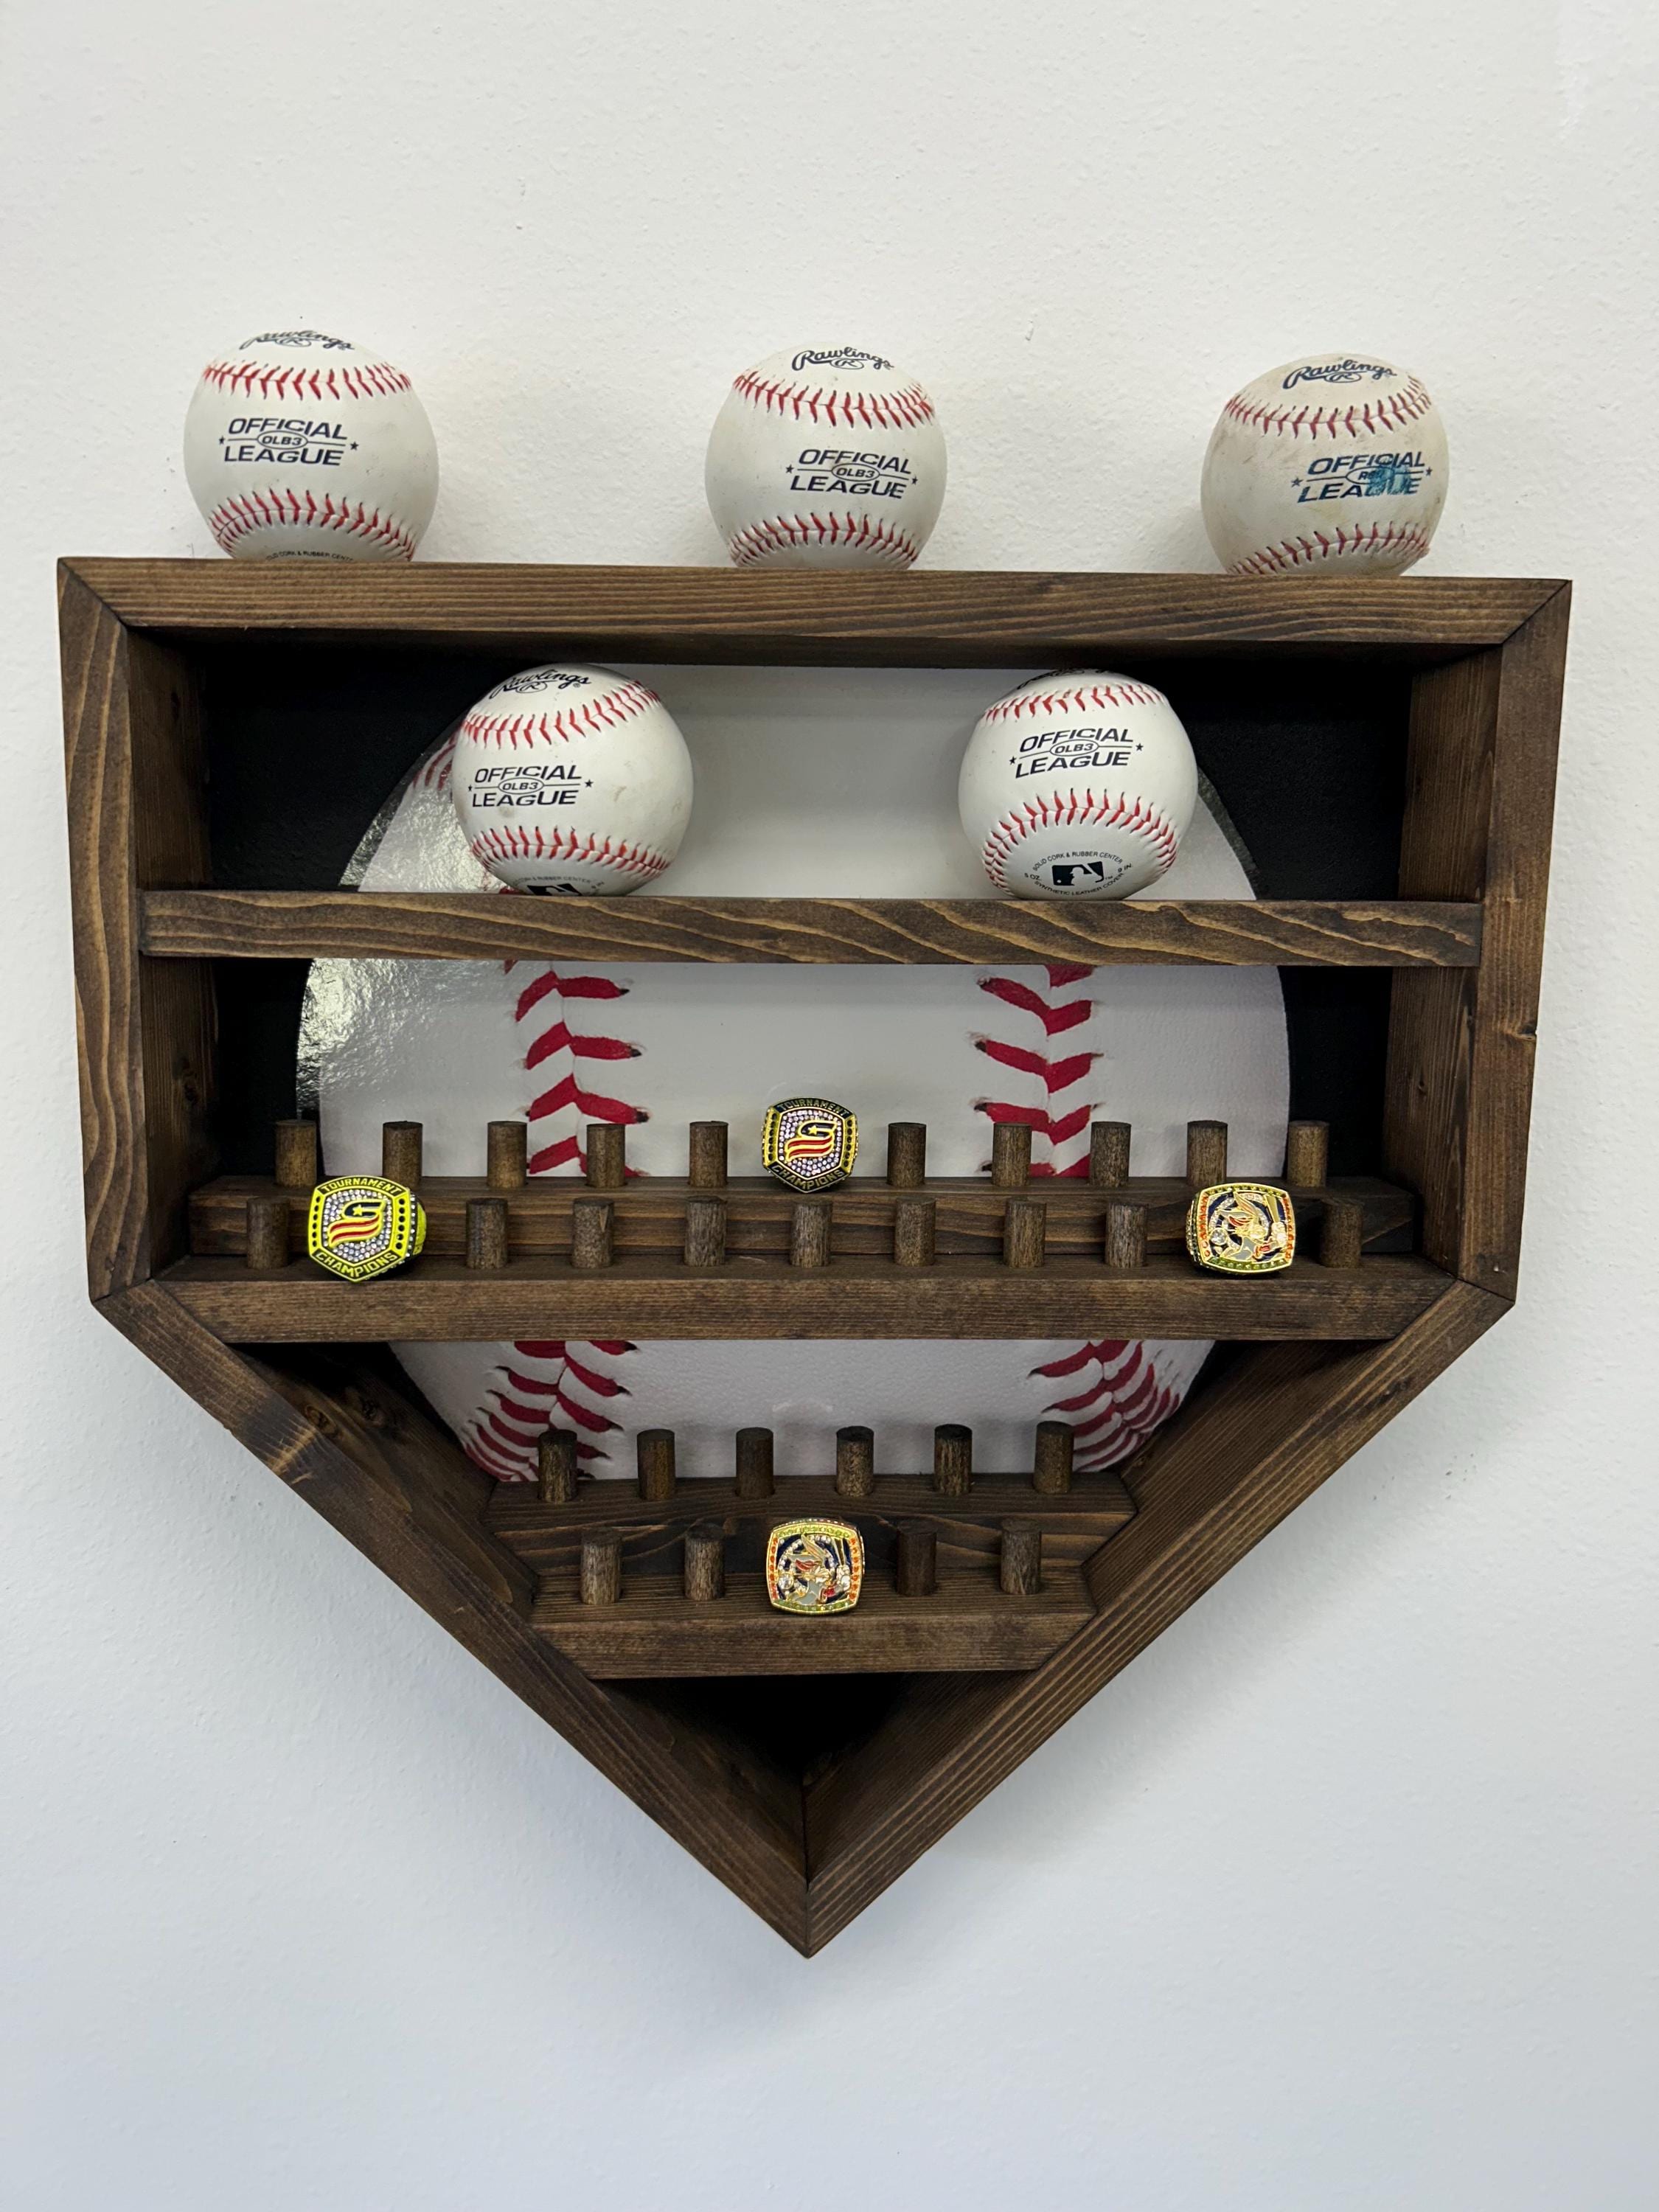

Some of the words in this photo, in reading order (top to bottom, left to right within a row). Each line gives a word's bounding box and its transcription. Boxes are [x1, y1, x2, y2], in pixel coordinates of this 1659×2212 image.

[792, 347, 894, 371] Rawlings
[1282, 359, 1397, 389] Rawlings
[229, 418, 347, 439] OFFICIAL
[262, 436, 302, 446] OLB3
[225, 445, 344, 466] LEAGUE
[799, 449, 911, 474] OFFICIAL
[1307, 451, 1425, 475] OFFICIAL
[836, 467, 875, 479] OLB3
[790, 475, 907, 499] LEAGUE
[1019, 728, 1134, 753] OFFICIAL
[1055, 742, 1093, 754] OLB3
[474, 765, 582, 783] OFFICIAL
[1015, 751, 1131, 779] LEAGUE
[503, 782, 538, 791] OLB3
[473, 790, 579, 807] LEAGUE
[1032, 858, 1047, 872] SOLID
[1047, 852, 1065, 862] CORK
[1099, 852, 1123, 864] CENTER
[1071, 886, 1102, 896] LEATHER
[777, 1099, 849, 1117] TOURNAMENT
[321, 1178, 403, 1194] TOURNAMENT
[771, 1165, 845, 1190] CHAMPIONS
[316, 1251, 398, 1278] CHAMPIONS
